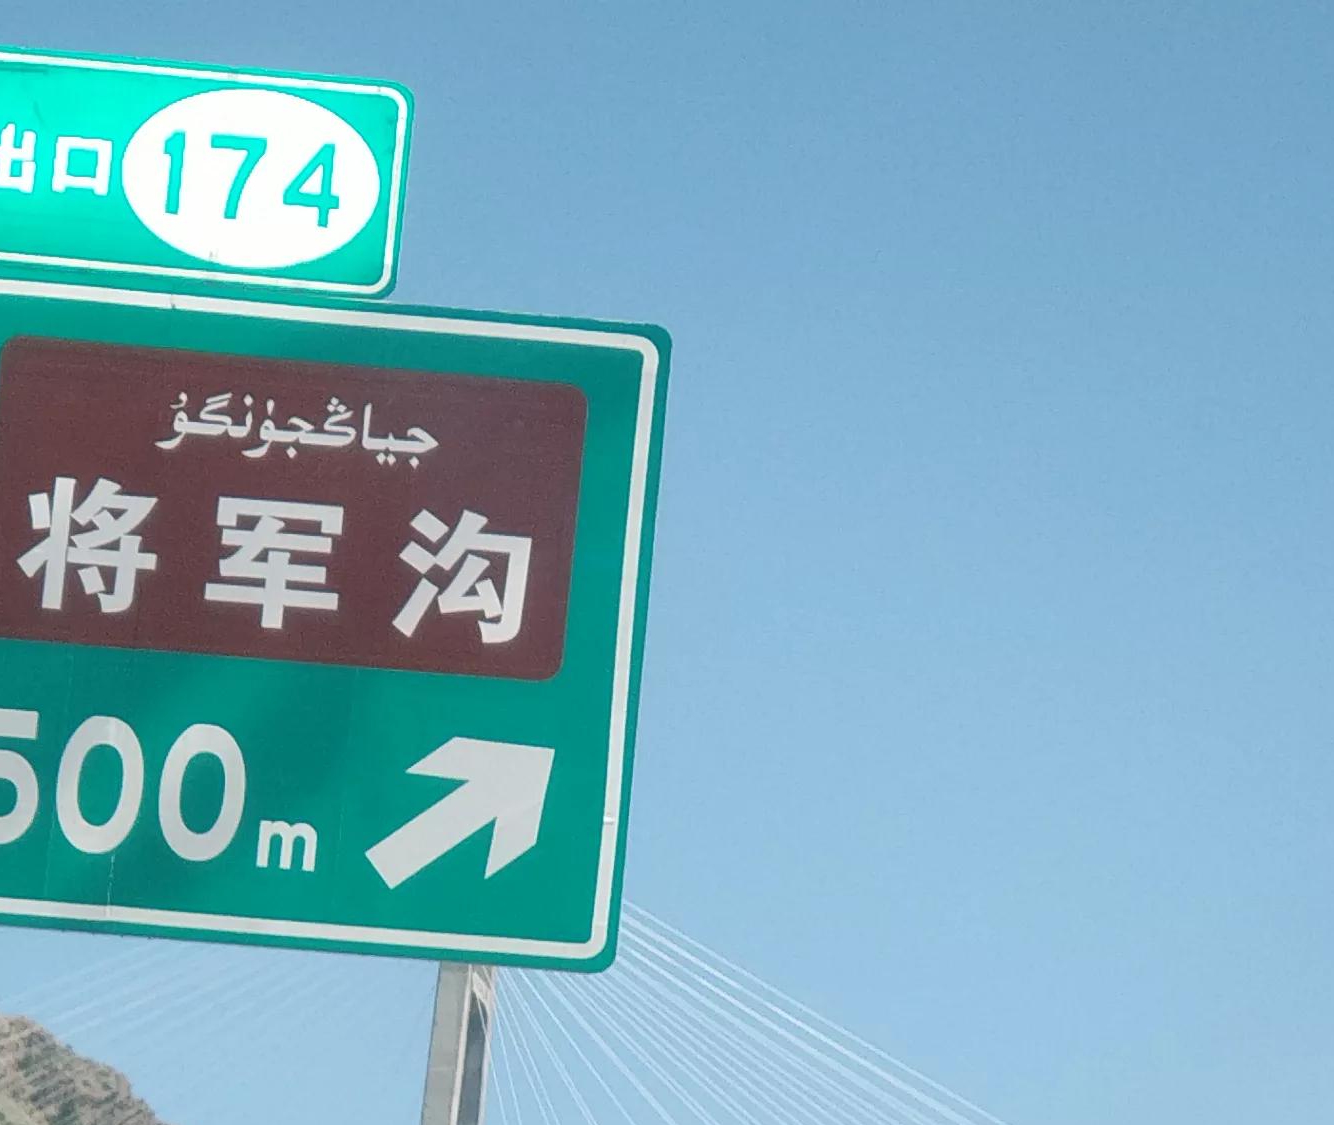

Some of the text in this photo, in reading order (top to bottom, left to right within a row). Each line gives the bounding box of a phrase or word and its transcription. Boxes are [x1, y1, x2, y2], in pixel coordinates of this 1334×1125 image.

[163, 130, 340, 228] 174
[16, 476, 533, 644] 将军沟
